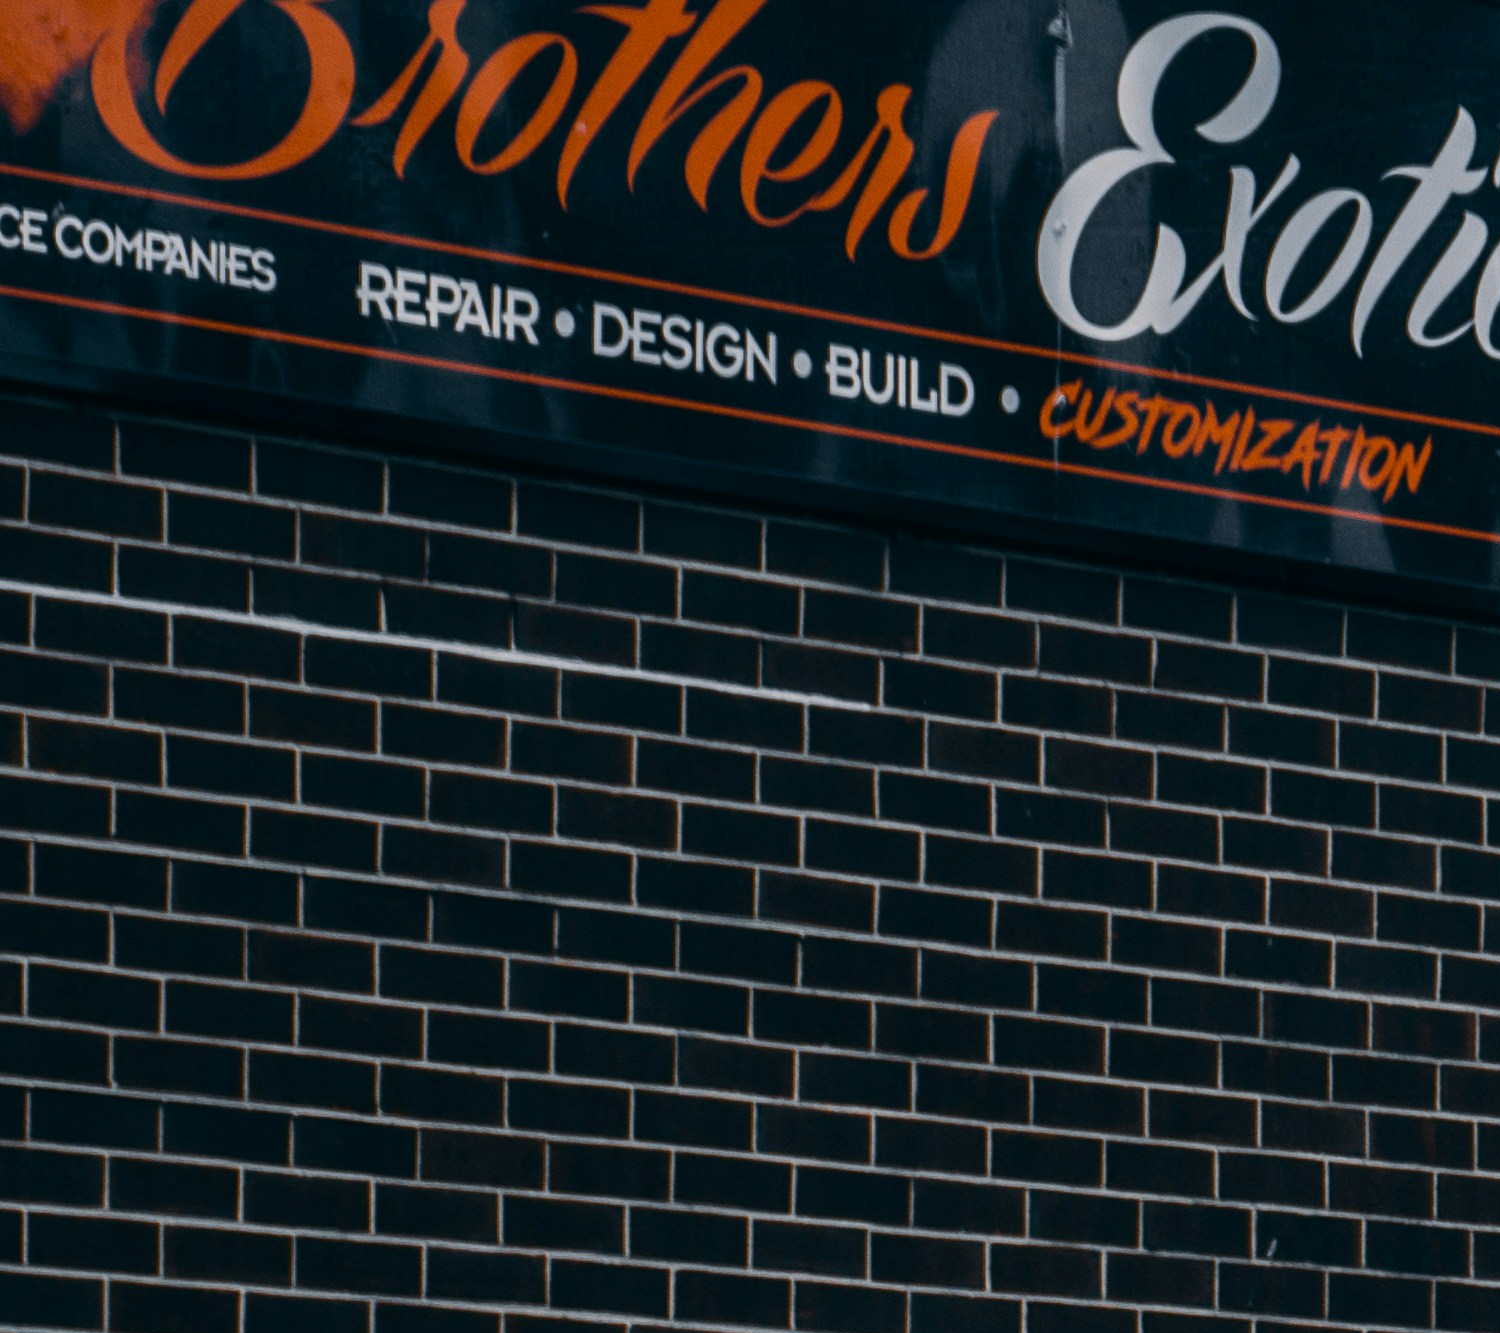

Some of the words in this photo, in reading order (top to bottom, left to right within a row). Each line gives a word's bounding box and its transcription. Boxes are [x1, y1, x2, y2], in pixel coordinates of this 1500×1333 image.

[54, 213, 277, 294] COMPANIES
[90, 0, 1000, 264] Brothers
[356, 260, 540, 346] REPAIR
[591, 301, 778, 386] DESIGN
[825, 341, 976, 418] BUILD
[1038, 377, 1434, 505] CUSTOMIZATION
